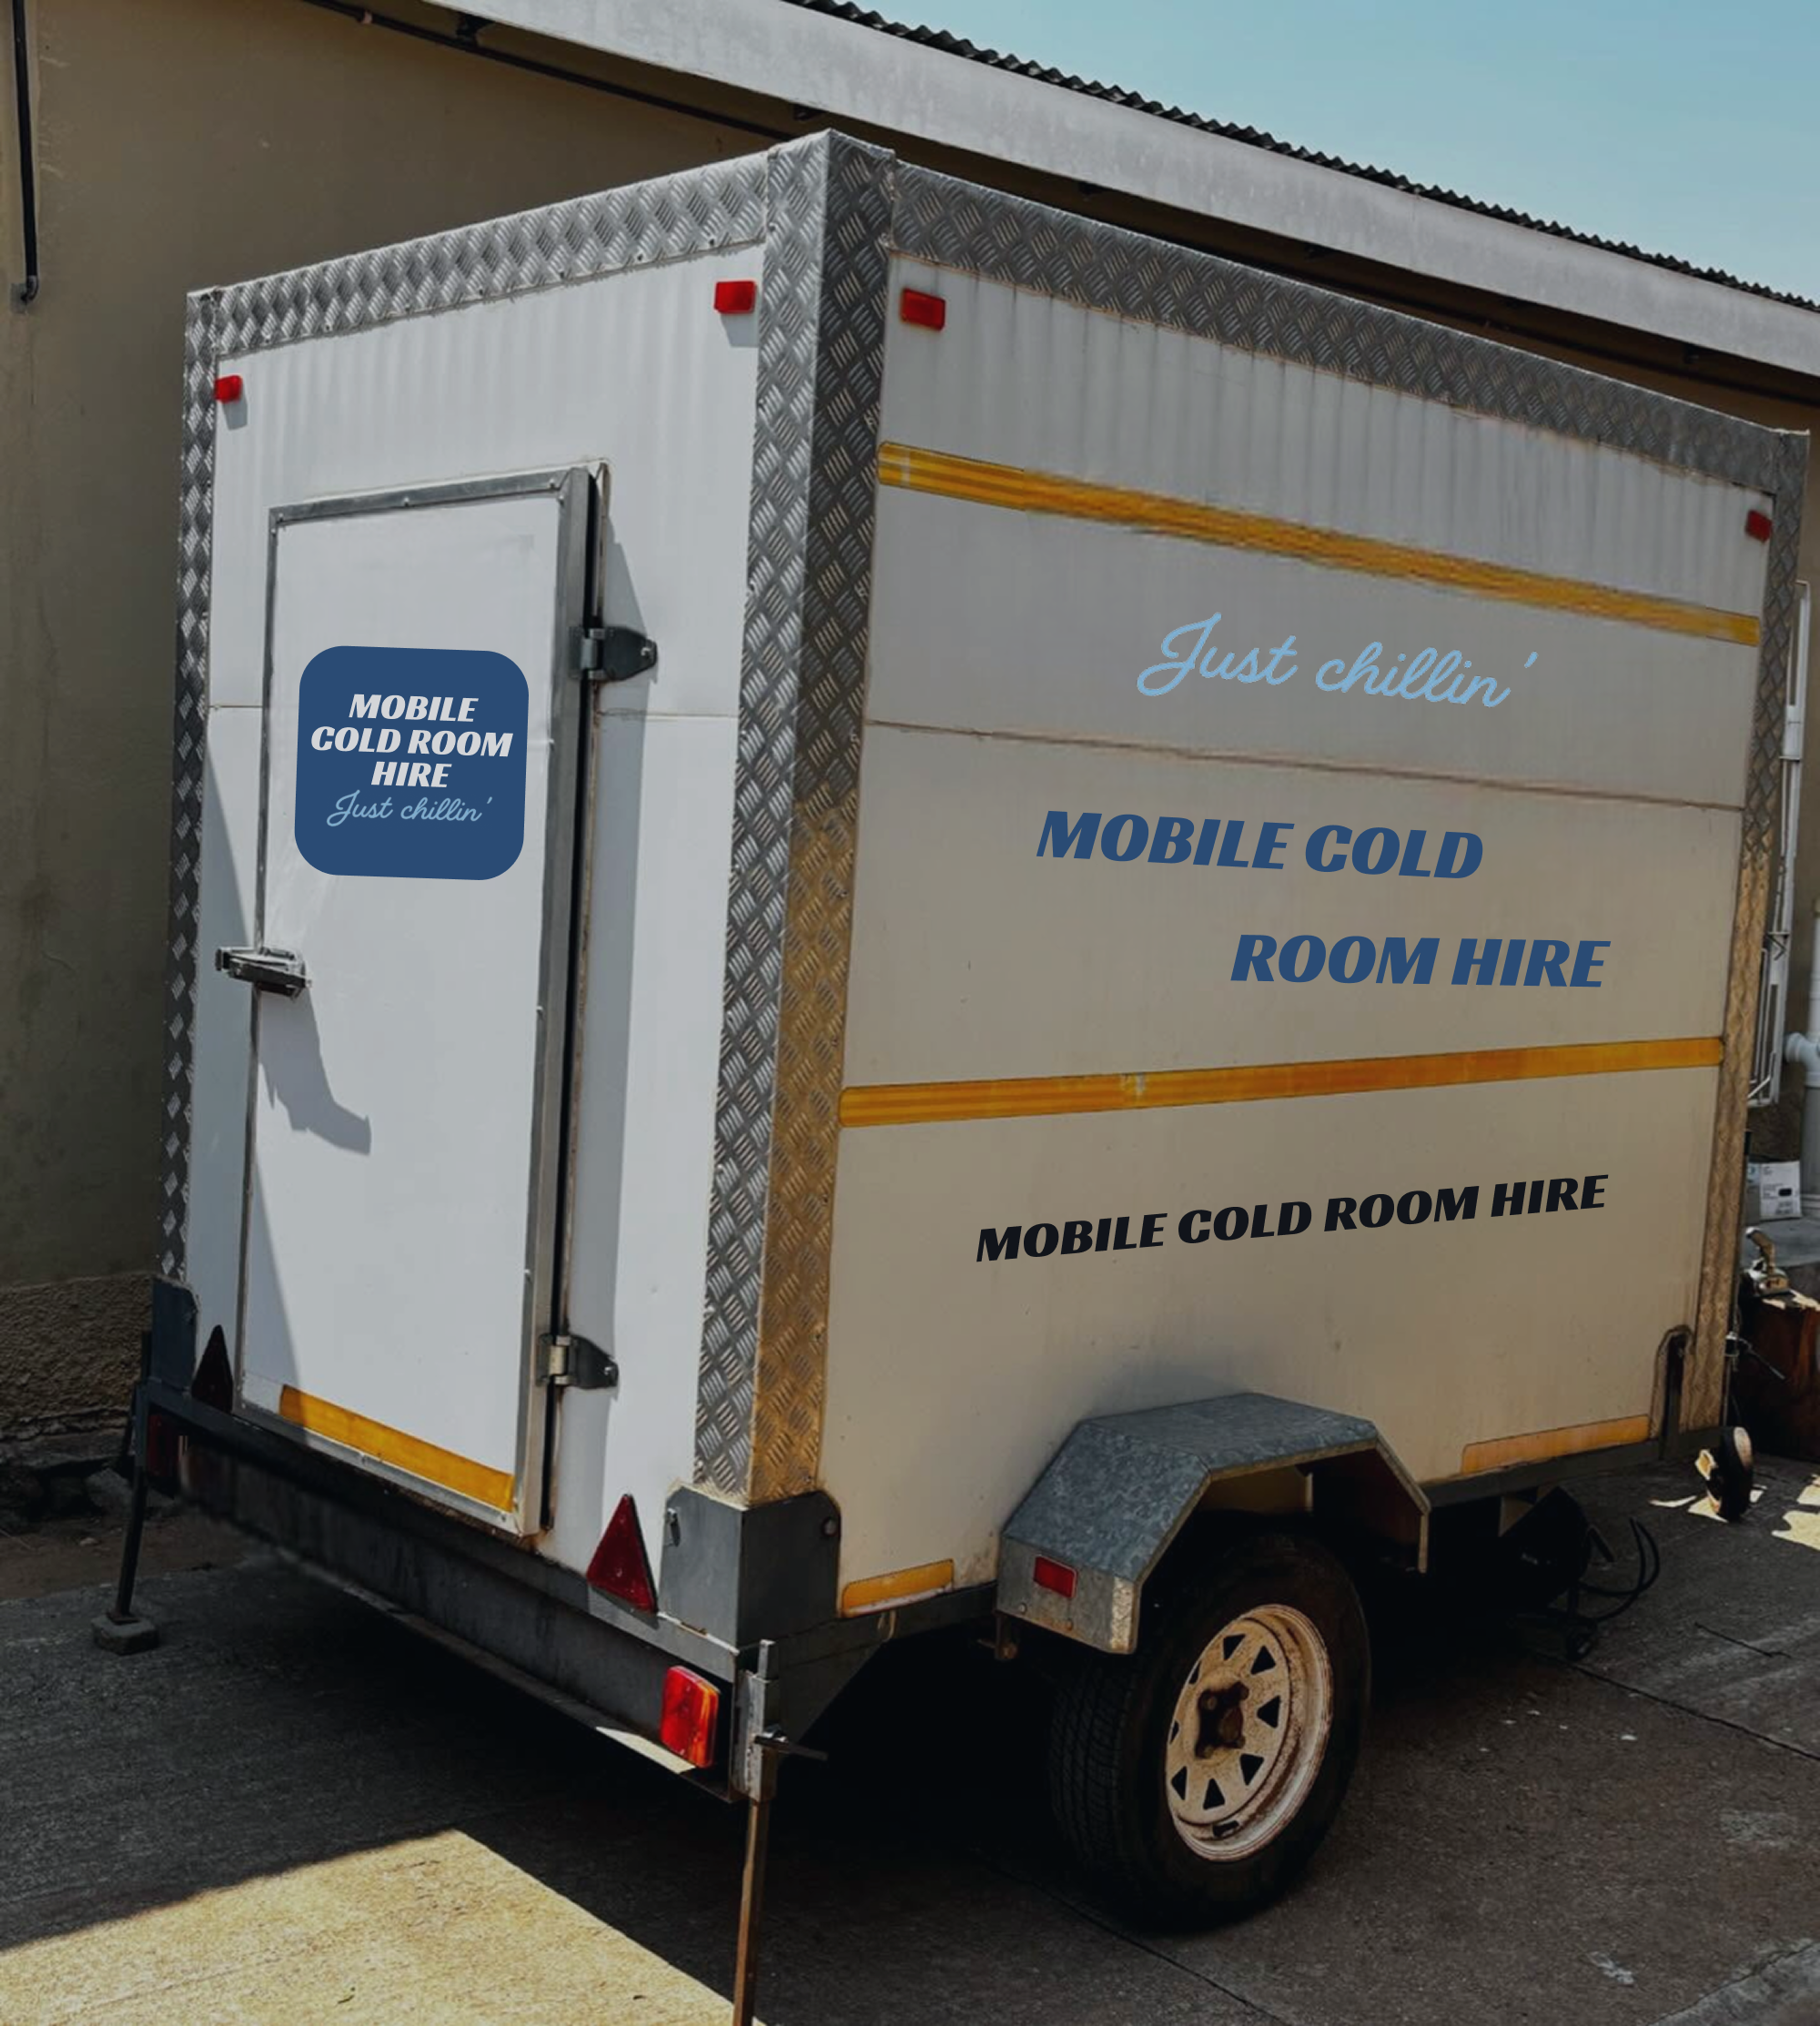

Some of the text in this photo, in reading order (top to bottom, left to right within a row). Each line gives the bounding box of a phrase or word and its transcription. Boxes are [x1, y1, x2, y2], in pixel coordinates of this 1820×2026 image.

[1137, 613, 1538, 707] Just chillin'
[348, 694, 480, 722] MOBILE
[310, 725, 514, 757] COLD ROOM
[370, 761, 452, 788] HIRE
[326, 789, 493, 827] Just chillin'
[1036, 810, 1484, 879] MOBILE COLD
[1230, 934, 1612, 988] ROOM HIRE
[976, 1174, 1609, 1262] MOBILE COLD ROOM HIRE
